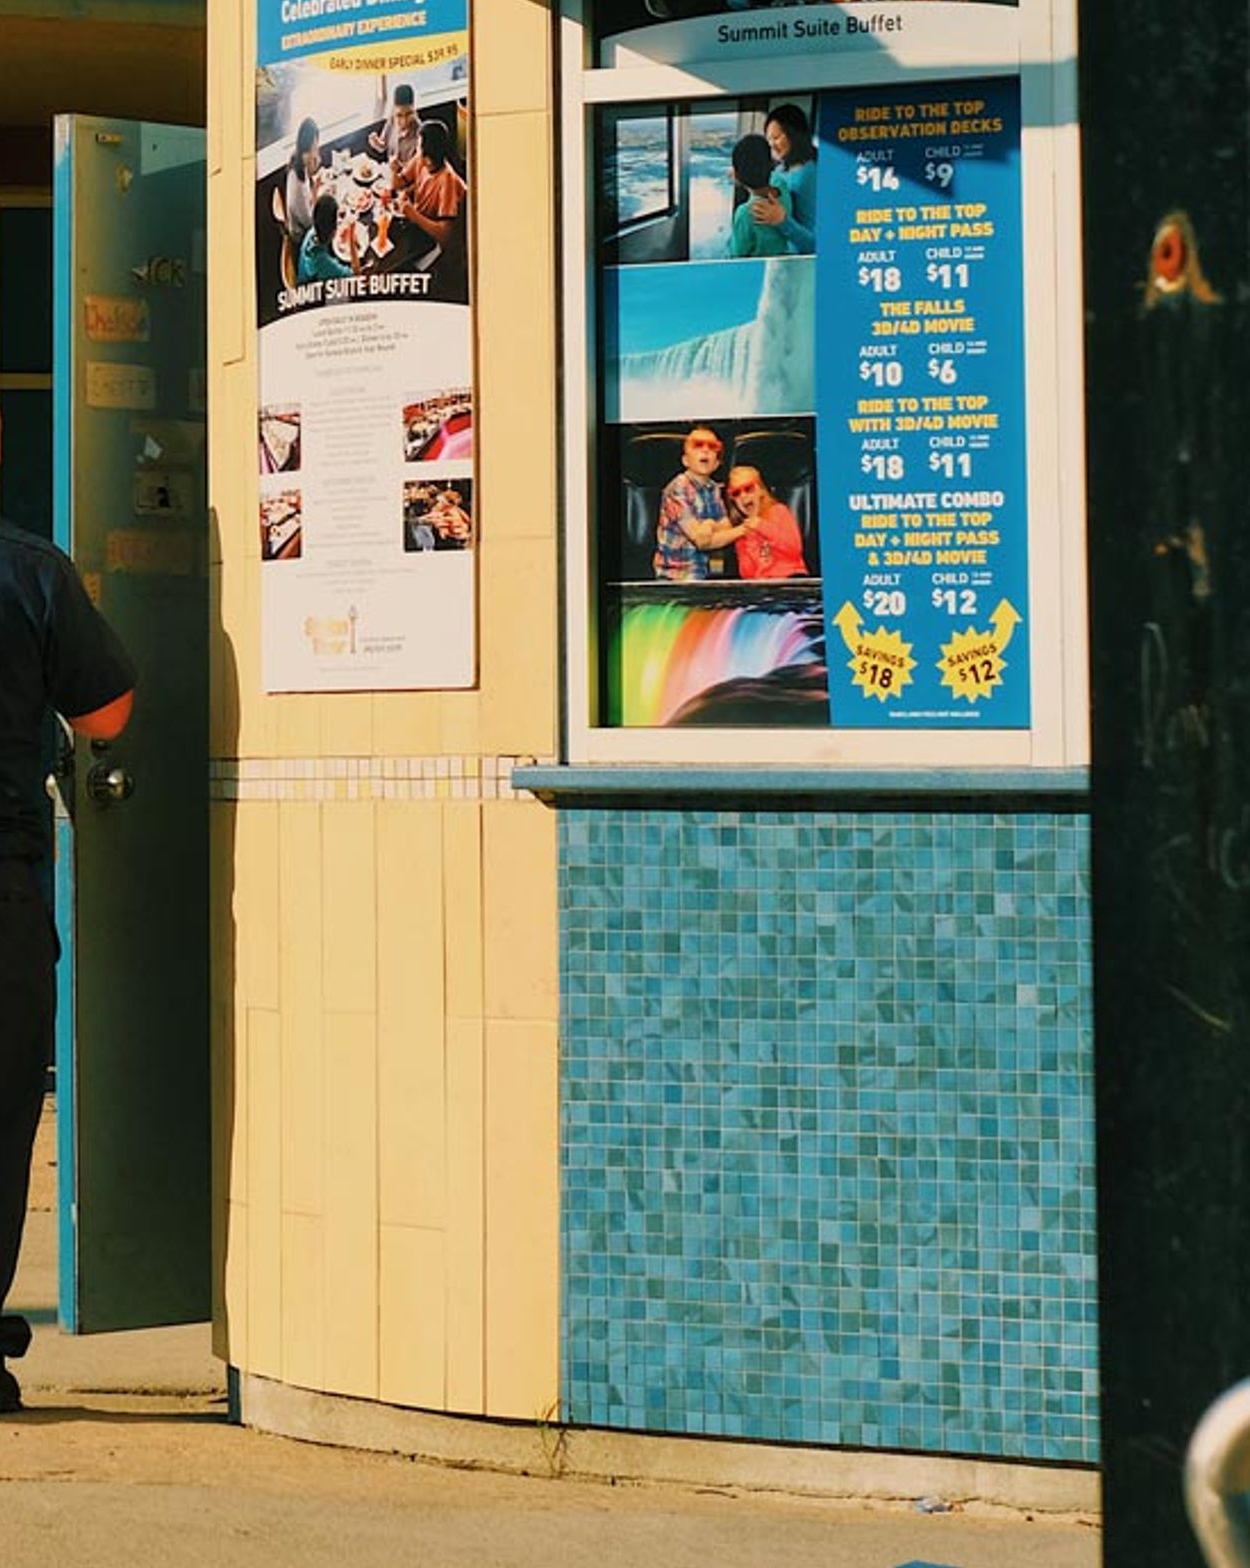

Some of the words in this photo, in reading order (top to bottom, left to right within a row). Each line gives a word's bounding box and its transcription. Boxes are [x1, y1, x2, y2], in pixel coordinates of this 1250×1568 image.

[717, 23, 788, 43] Summit
[793, 19, 840, 38] Suite
[845, 14, 902, 34] Buffet
[388, 52, 426, 69] SPECIAL
[855, 106, 890, 122] RIDE
[894, 104, 915, 119] TO
[919, 102, 949, 118] THE
[954, 100, 984, 115] TOP
[838, 121, 947, 141] OBSERVATION
[951, 118, 1003, 134] DECKS
[857, 148, 894, 163] ADULT
[925, 145, 961, 158] CHILD
[857, 165, 900, 191] $14
[925, 162, 954, 187] $9
[856, 209, 892, 224] RIDE
[896, 207, 917, 222] TO
[920, 205, 951, 220] THE
[954, 204, 986, 219] TOP
[850, 227, 882, 243] DAY
[884, 230, 896, 241] +
[898, 224, 947, 240] NIGHT
[950, 221, 994, 237] PASS
[857, 250, 897, 263] ADULT
[925, 246, 962, 260] CHILD
[858, 266, 901, 292] $18
[926, 263, 969, 288] $11
[277, 280, 325, 312] SUMMIT
[325, 275, 368, 300] SUITE
[369, 272, 432, 295] BUFFET
[880, 301, 911, 317] THE
[914, 298, 966, 315] FALLS
[871, 320, 921, 336] 3D/4D
[924, 316, 975, 334] MOVIE
[859, 344, 897, 358] ADULT
[928, 341, 965, 355] CHILD
[859, 360, 903, 387] $10
[928, 357, 957, 384] $6
[857, 399, 894, 414] RIDE
[898, 397, 919, 412] TO
[921, 396, 953, 412] THE
[956, 395, 988, 410] TOP
[848, 417, 891, 433] WITH
[895, 415, 945, 431] 3D/4D
[948, 413, 999, 429] MOVIE
[861, 437, 899, 451] ADULT
[929, 435, 965, 448] CHILD
[861, 454, 904, 481] $18
[929, 451, 971, 478] $11
[850, 493, 937, 511] ULTIMATE
[941, 490, 1004, 508] COMBO
[861, 513, 898, 529] RIDE
[901, 513, 923, 528] TO
[925, 512, 957, 527] THE
[959, 510, 993, 526] TOP
[854, 532, 887, 548] DAY
[889, 535, 901, 546] +
[904, 531, 953, 547] NIGHT
[956, 530, 1000, 545] PASS
[884, 550, 932, 565] 3D/4D
[936, 549, 987, 565] MOVIE
[863, 572, 901, 586] ADULT
[931, 572, 968, 585] CHILD
[863, 588, 906, 616] $20
[932, 587, 977, 615] $12
[856, 644, 905, 668] SAVINGS
[947, 643, 997, 667] SAVINGS
[860, 660, 893, 689] $18
[958, 659, 996, 684] $12
